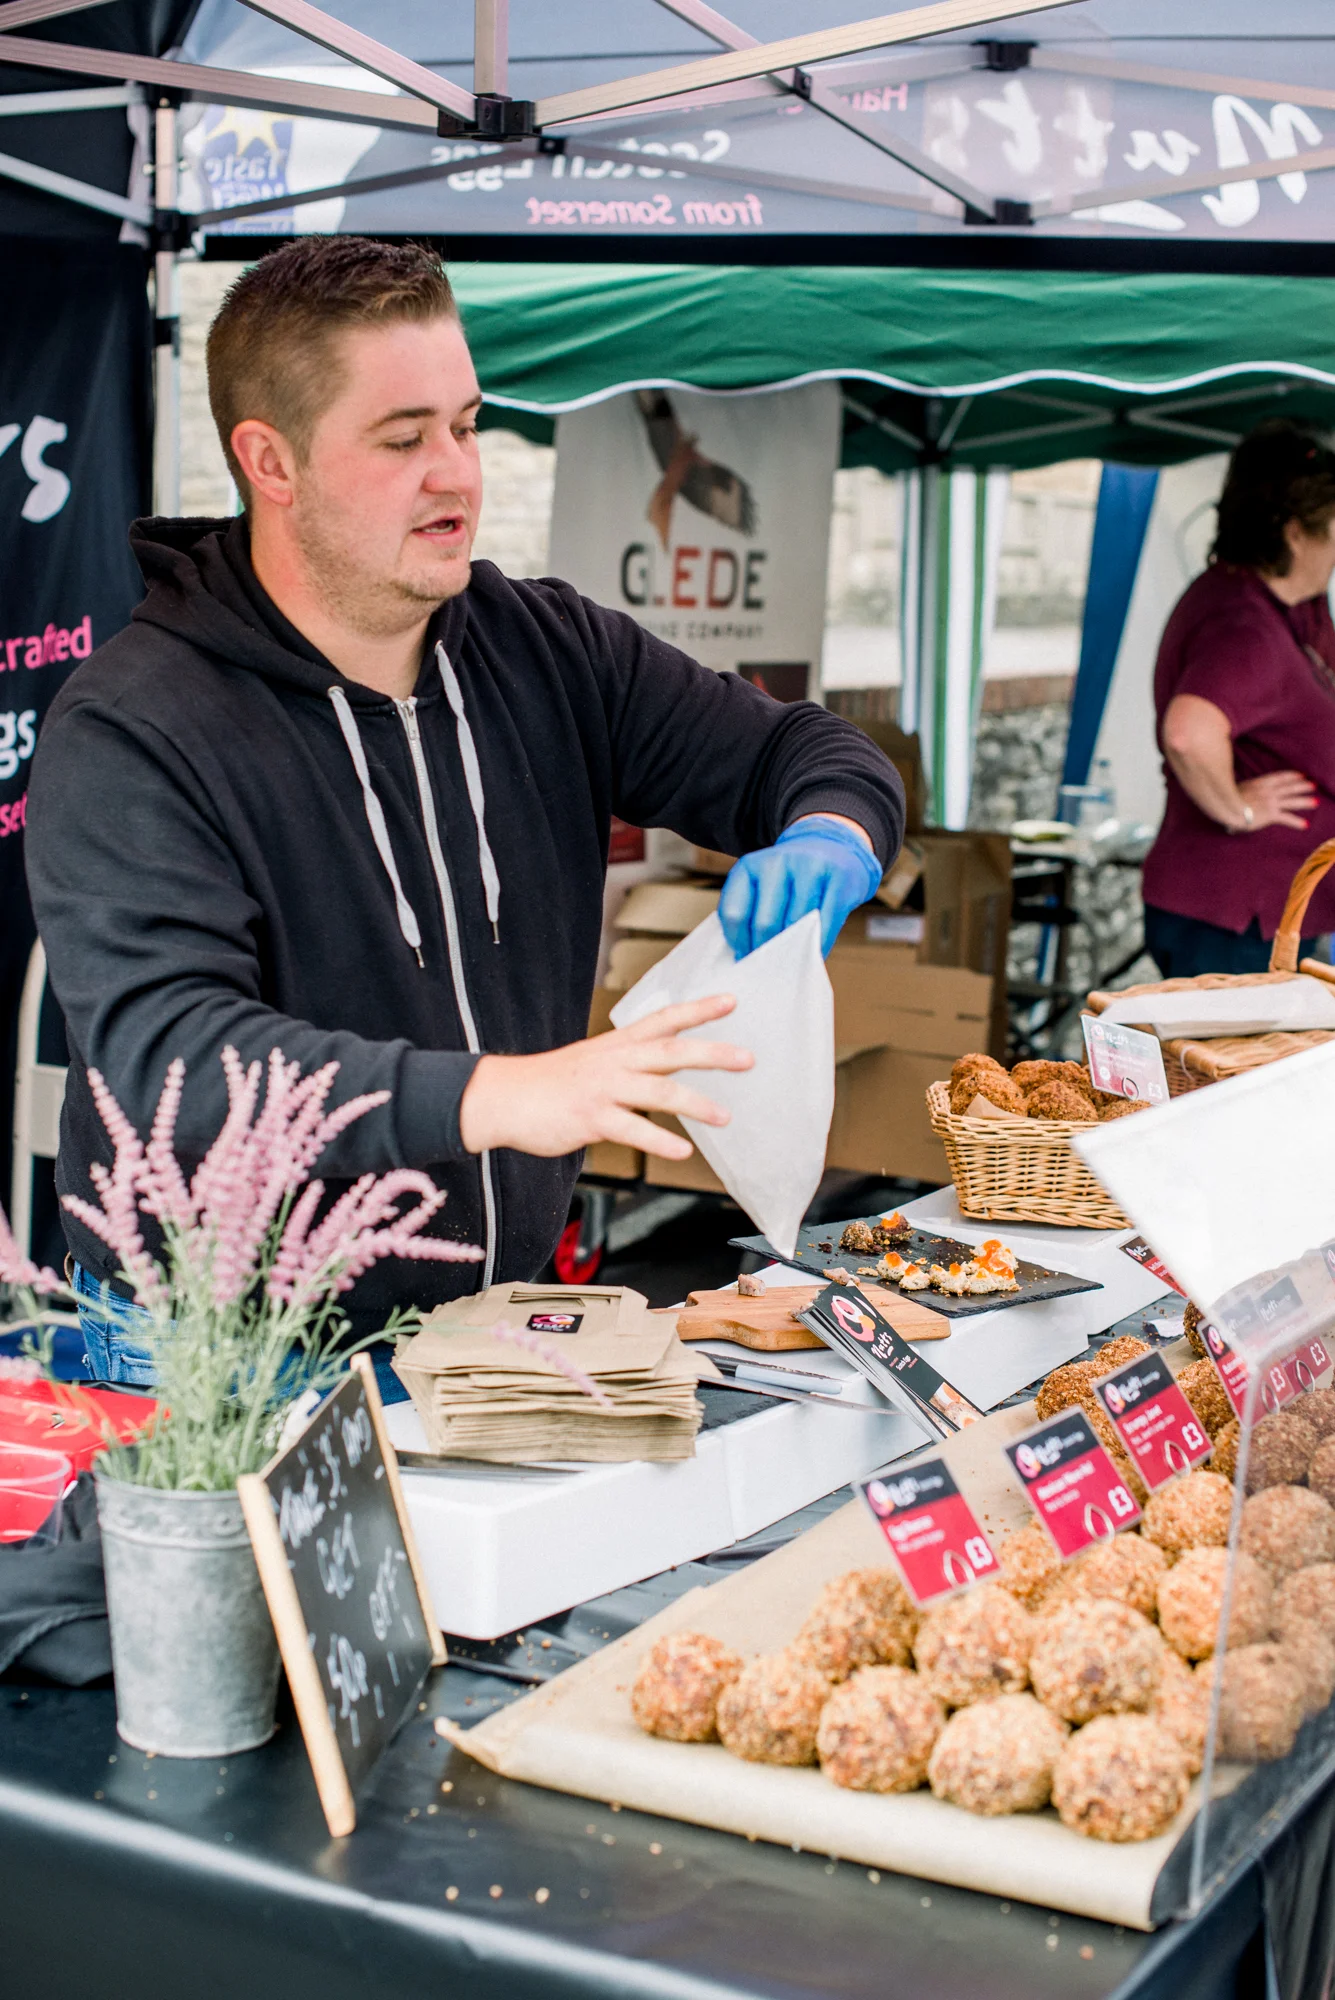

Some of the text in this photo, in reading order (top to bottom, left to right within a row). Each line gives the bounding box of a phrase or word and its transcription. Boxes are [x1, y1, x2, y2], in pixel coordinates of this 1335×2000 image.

[621, 542, 767, 610] GEDE
[0, 615, 92, 672] rafted
[1309, 1342, 1326, 1367] £3
[1269, 1366, 1286, 1392] £3
